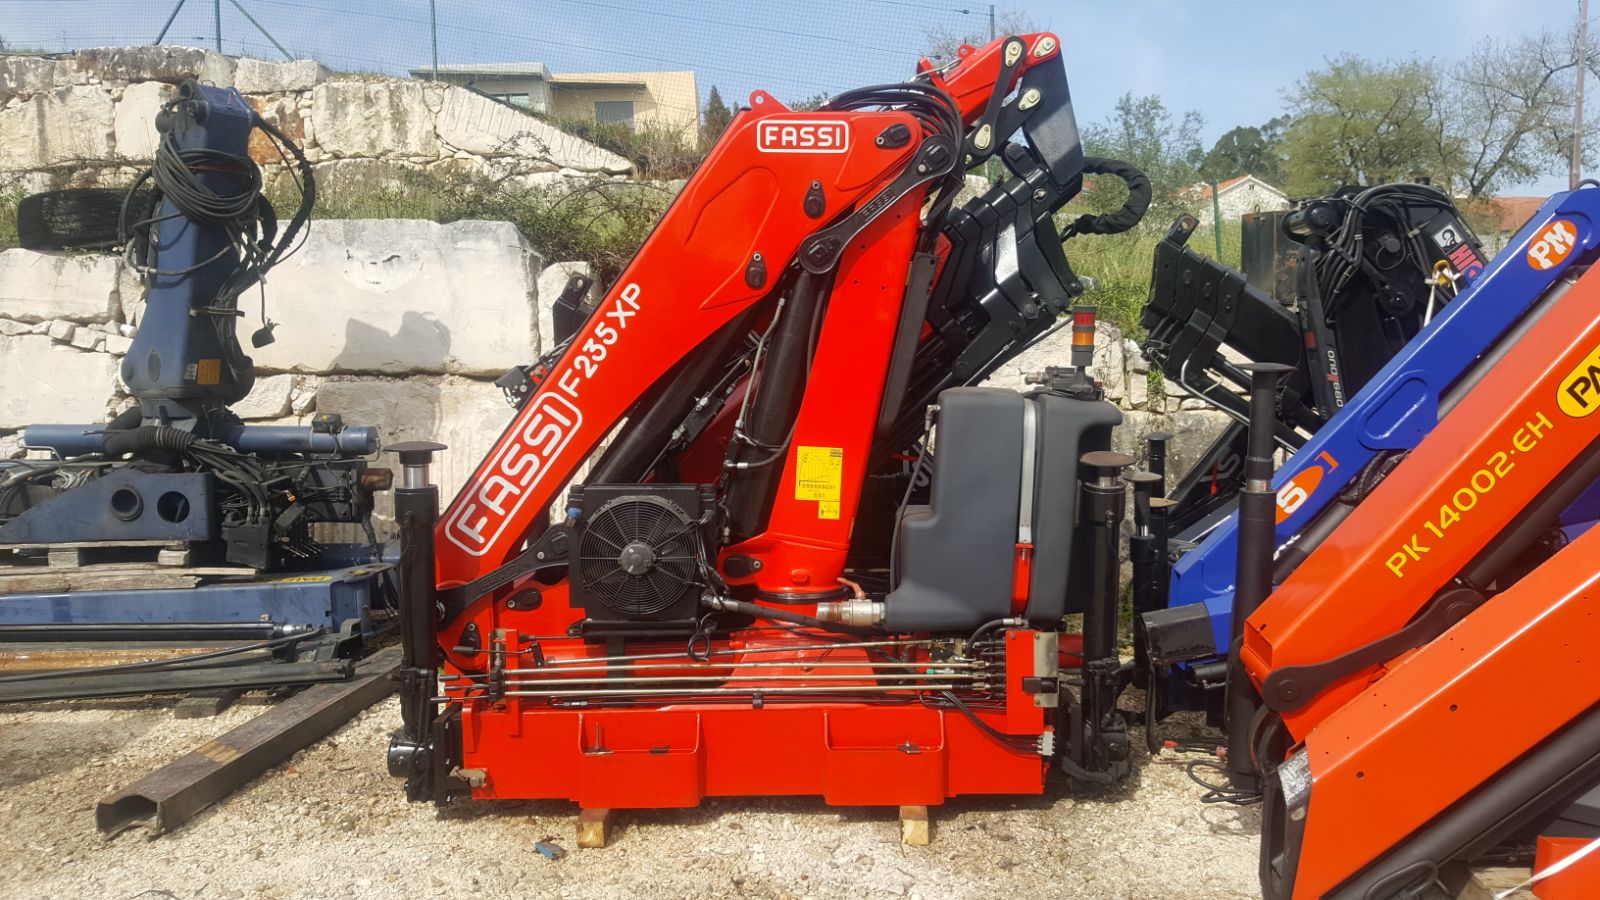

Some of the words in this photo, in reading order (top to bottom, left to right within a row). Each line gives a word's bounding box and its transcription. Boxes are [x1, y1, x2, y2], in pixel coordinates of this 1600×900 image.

[764, 125, 841, 148] FASSI
[1528, 221, 1575, 270] PM
[1566, 354, 1600, 409] PA
[456, 403, 572, 544] FASSI
[1385, 533, 1431, 579] PK
